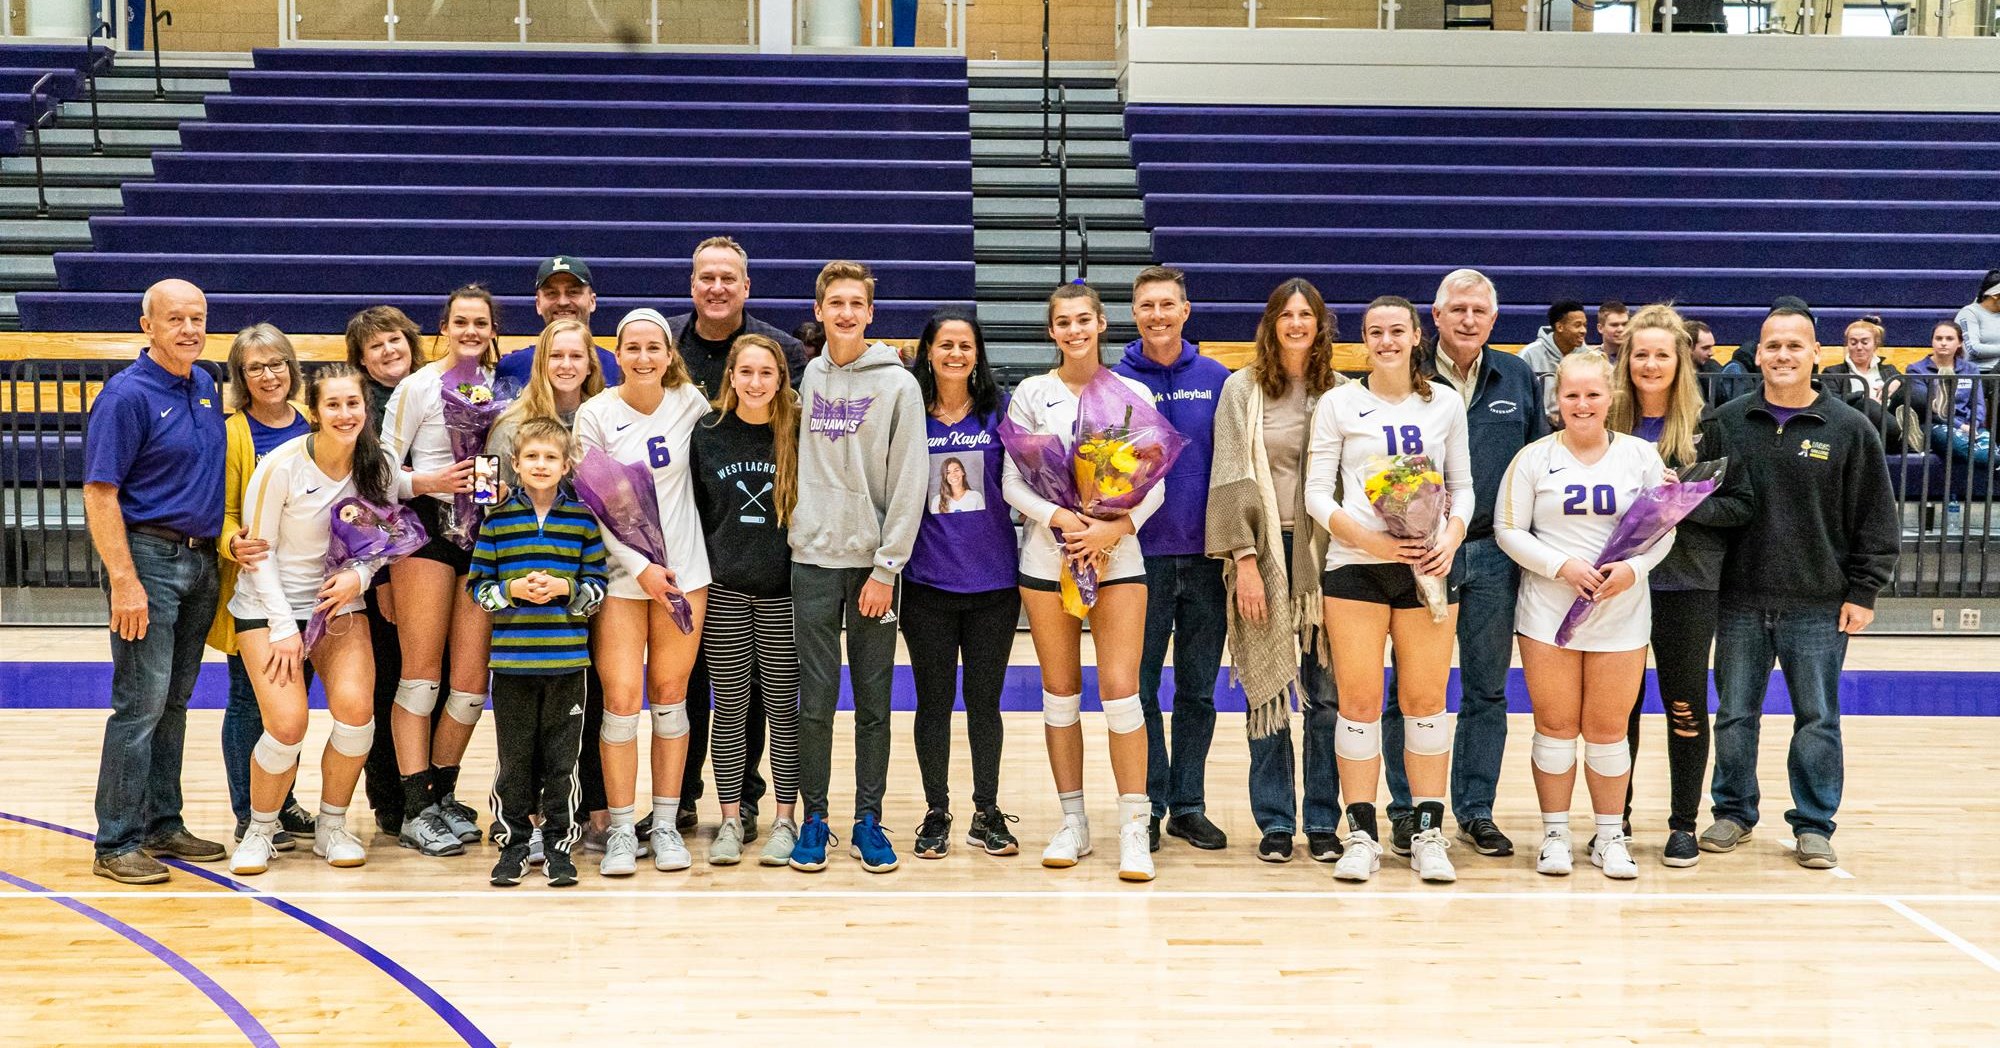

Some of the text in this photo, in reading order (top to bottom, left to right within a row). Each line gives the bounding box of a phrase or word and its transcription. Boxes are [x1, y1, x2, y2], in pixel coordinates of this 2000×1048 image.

[553, 258, 570, 270] L
[927, 430, 992, 448] am Kayla
[1382, 425, 1423, 456] 18
[647, 436, 671, 469] 6
[717, 461, 776, 480] WEST LACRO
[1563, 484, 1617, 515] 20
